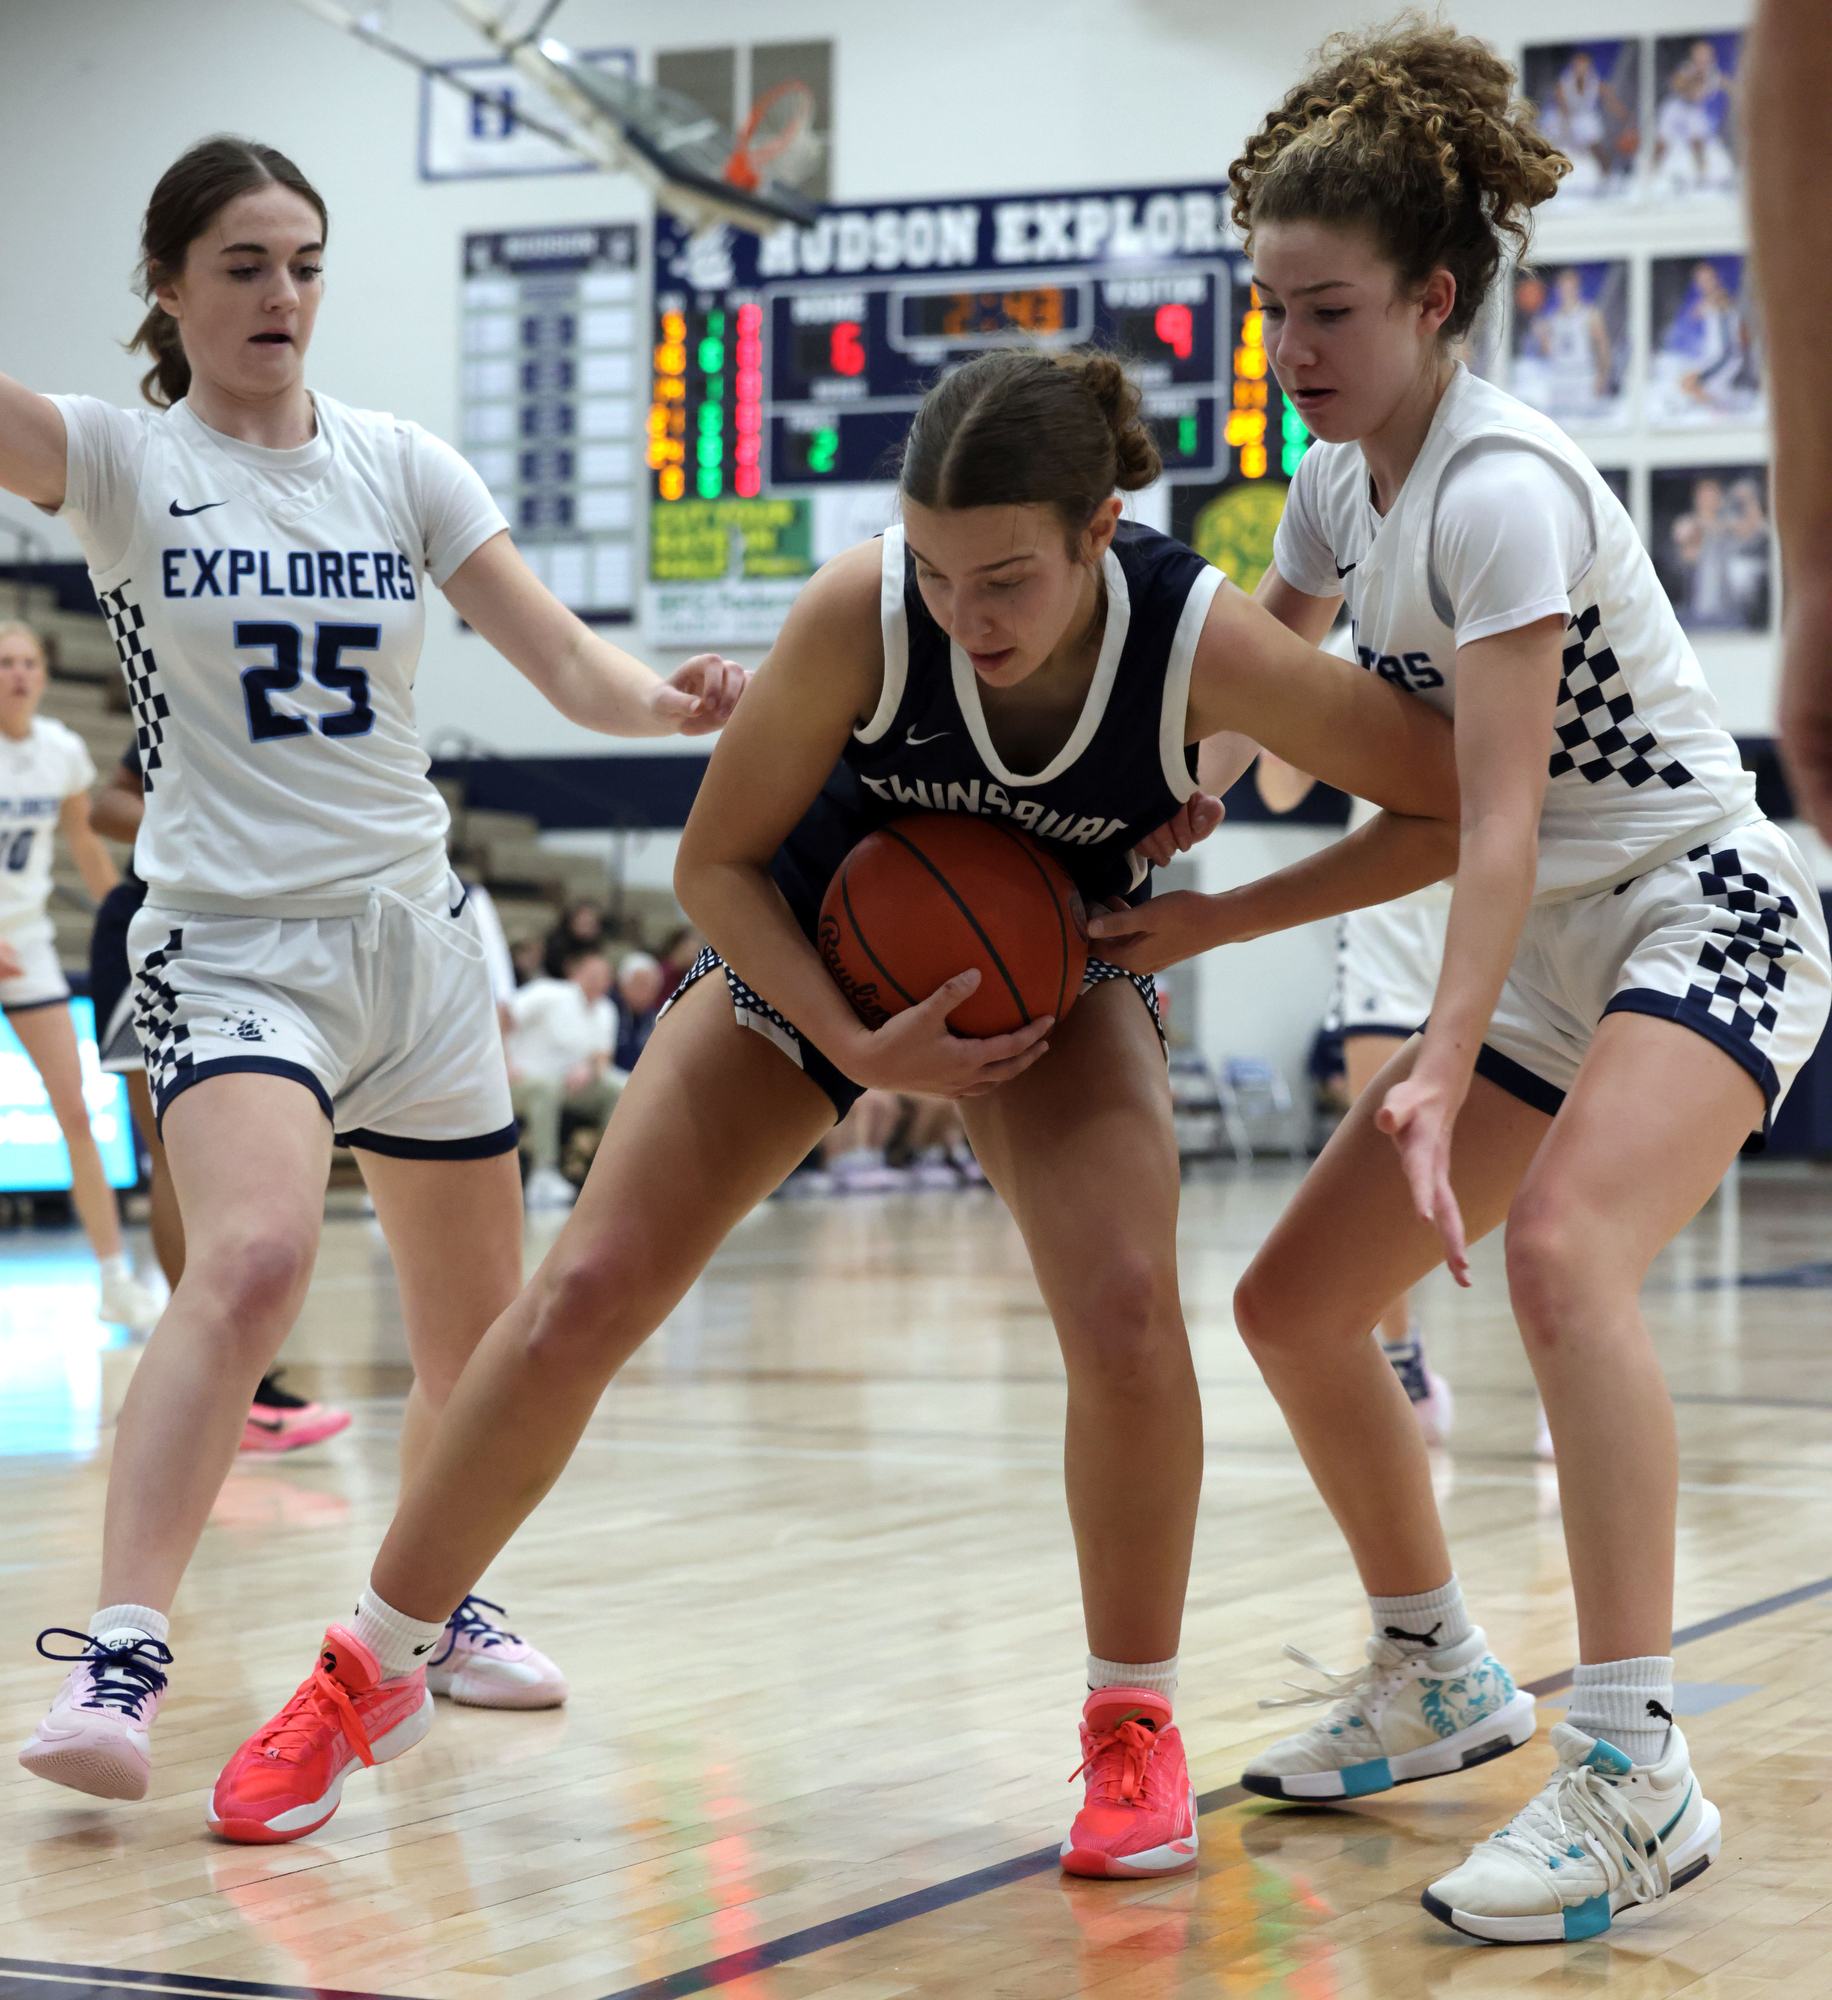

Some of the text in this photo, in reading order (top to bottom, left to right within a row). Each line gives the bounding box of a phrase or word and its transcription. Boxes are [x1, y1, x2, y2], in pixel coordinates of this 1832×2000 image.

[757, 206, 981, 277] HUDSON
[830, 320, 866, 377] 6
[1154, 303, 1193, 361] 9
[162, 548, 416, 600] EXPLORERS
[233, 620, 382, 743] 25
